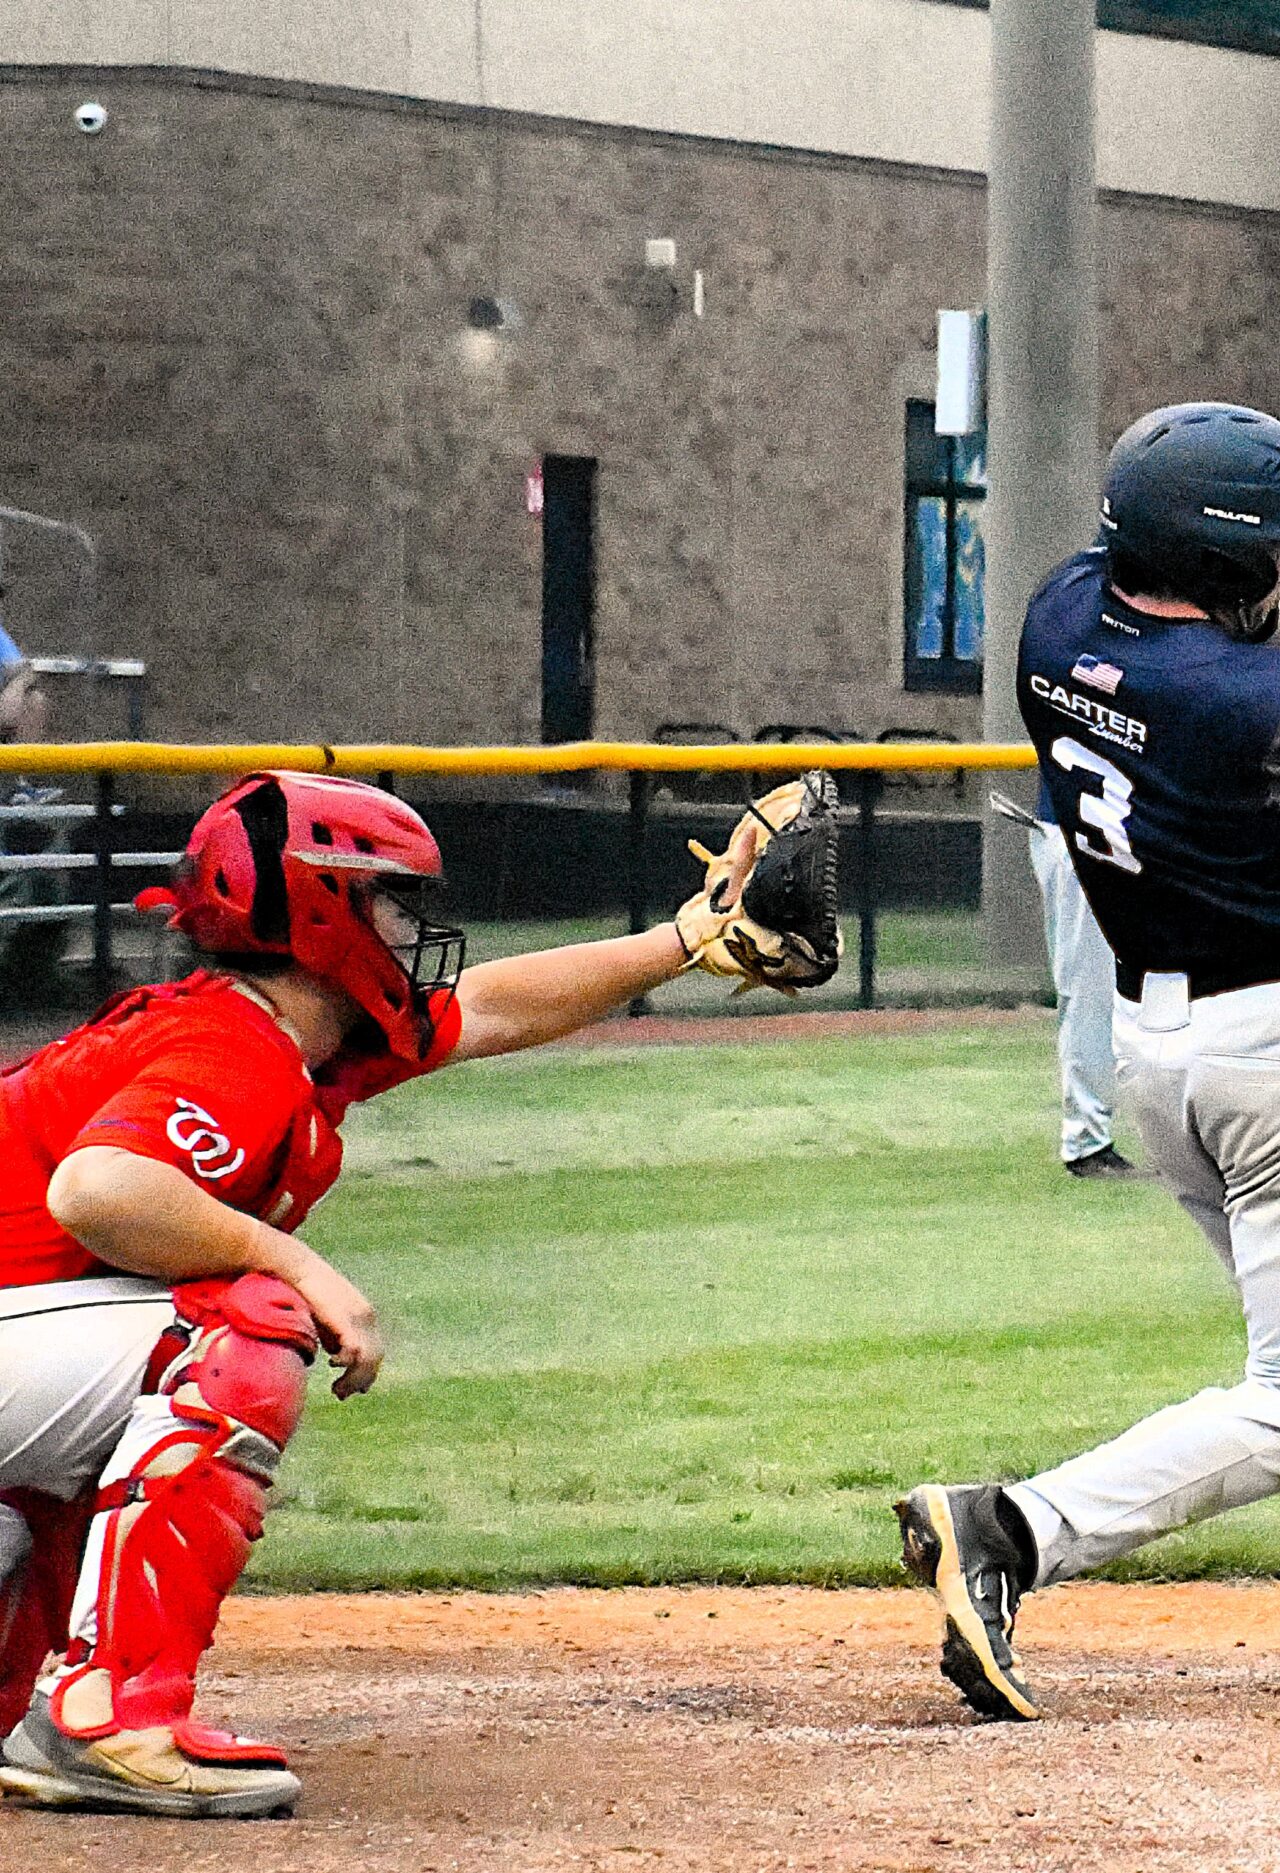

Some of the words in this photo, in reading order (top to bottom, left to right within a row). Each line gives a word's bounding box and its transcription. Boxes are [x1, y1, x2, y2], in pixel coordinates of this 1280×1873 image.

[1030, 675, 1147, 743] CARTER
[1088, 721, 1144, 754] Lumber
[1051, 736, 1142, 874] 3
